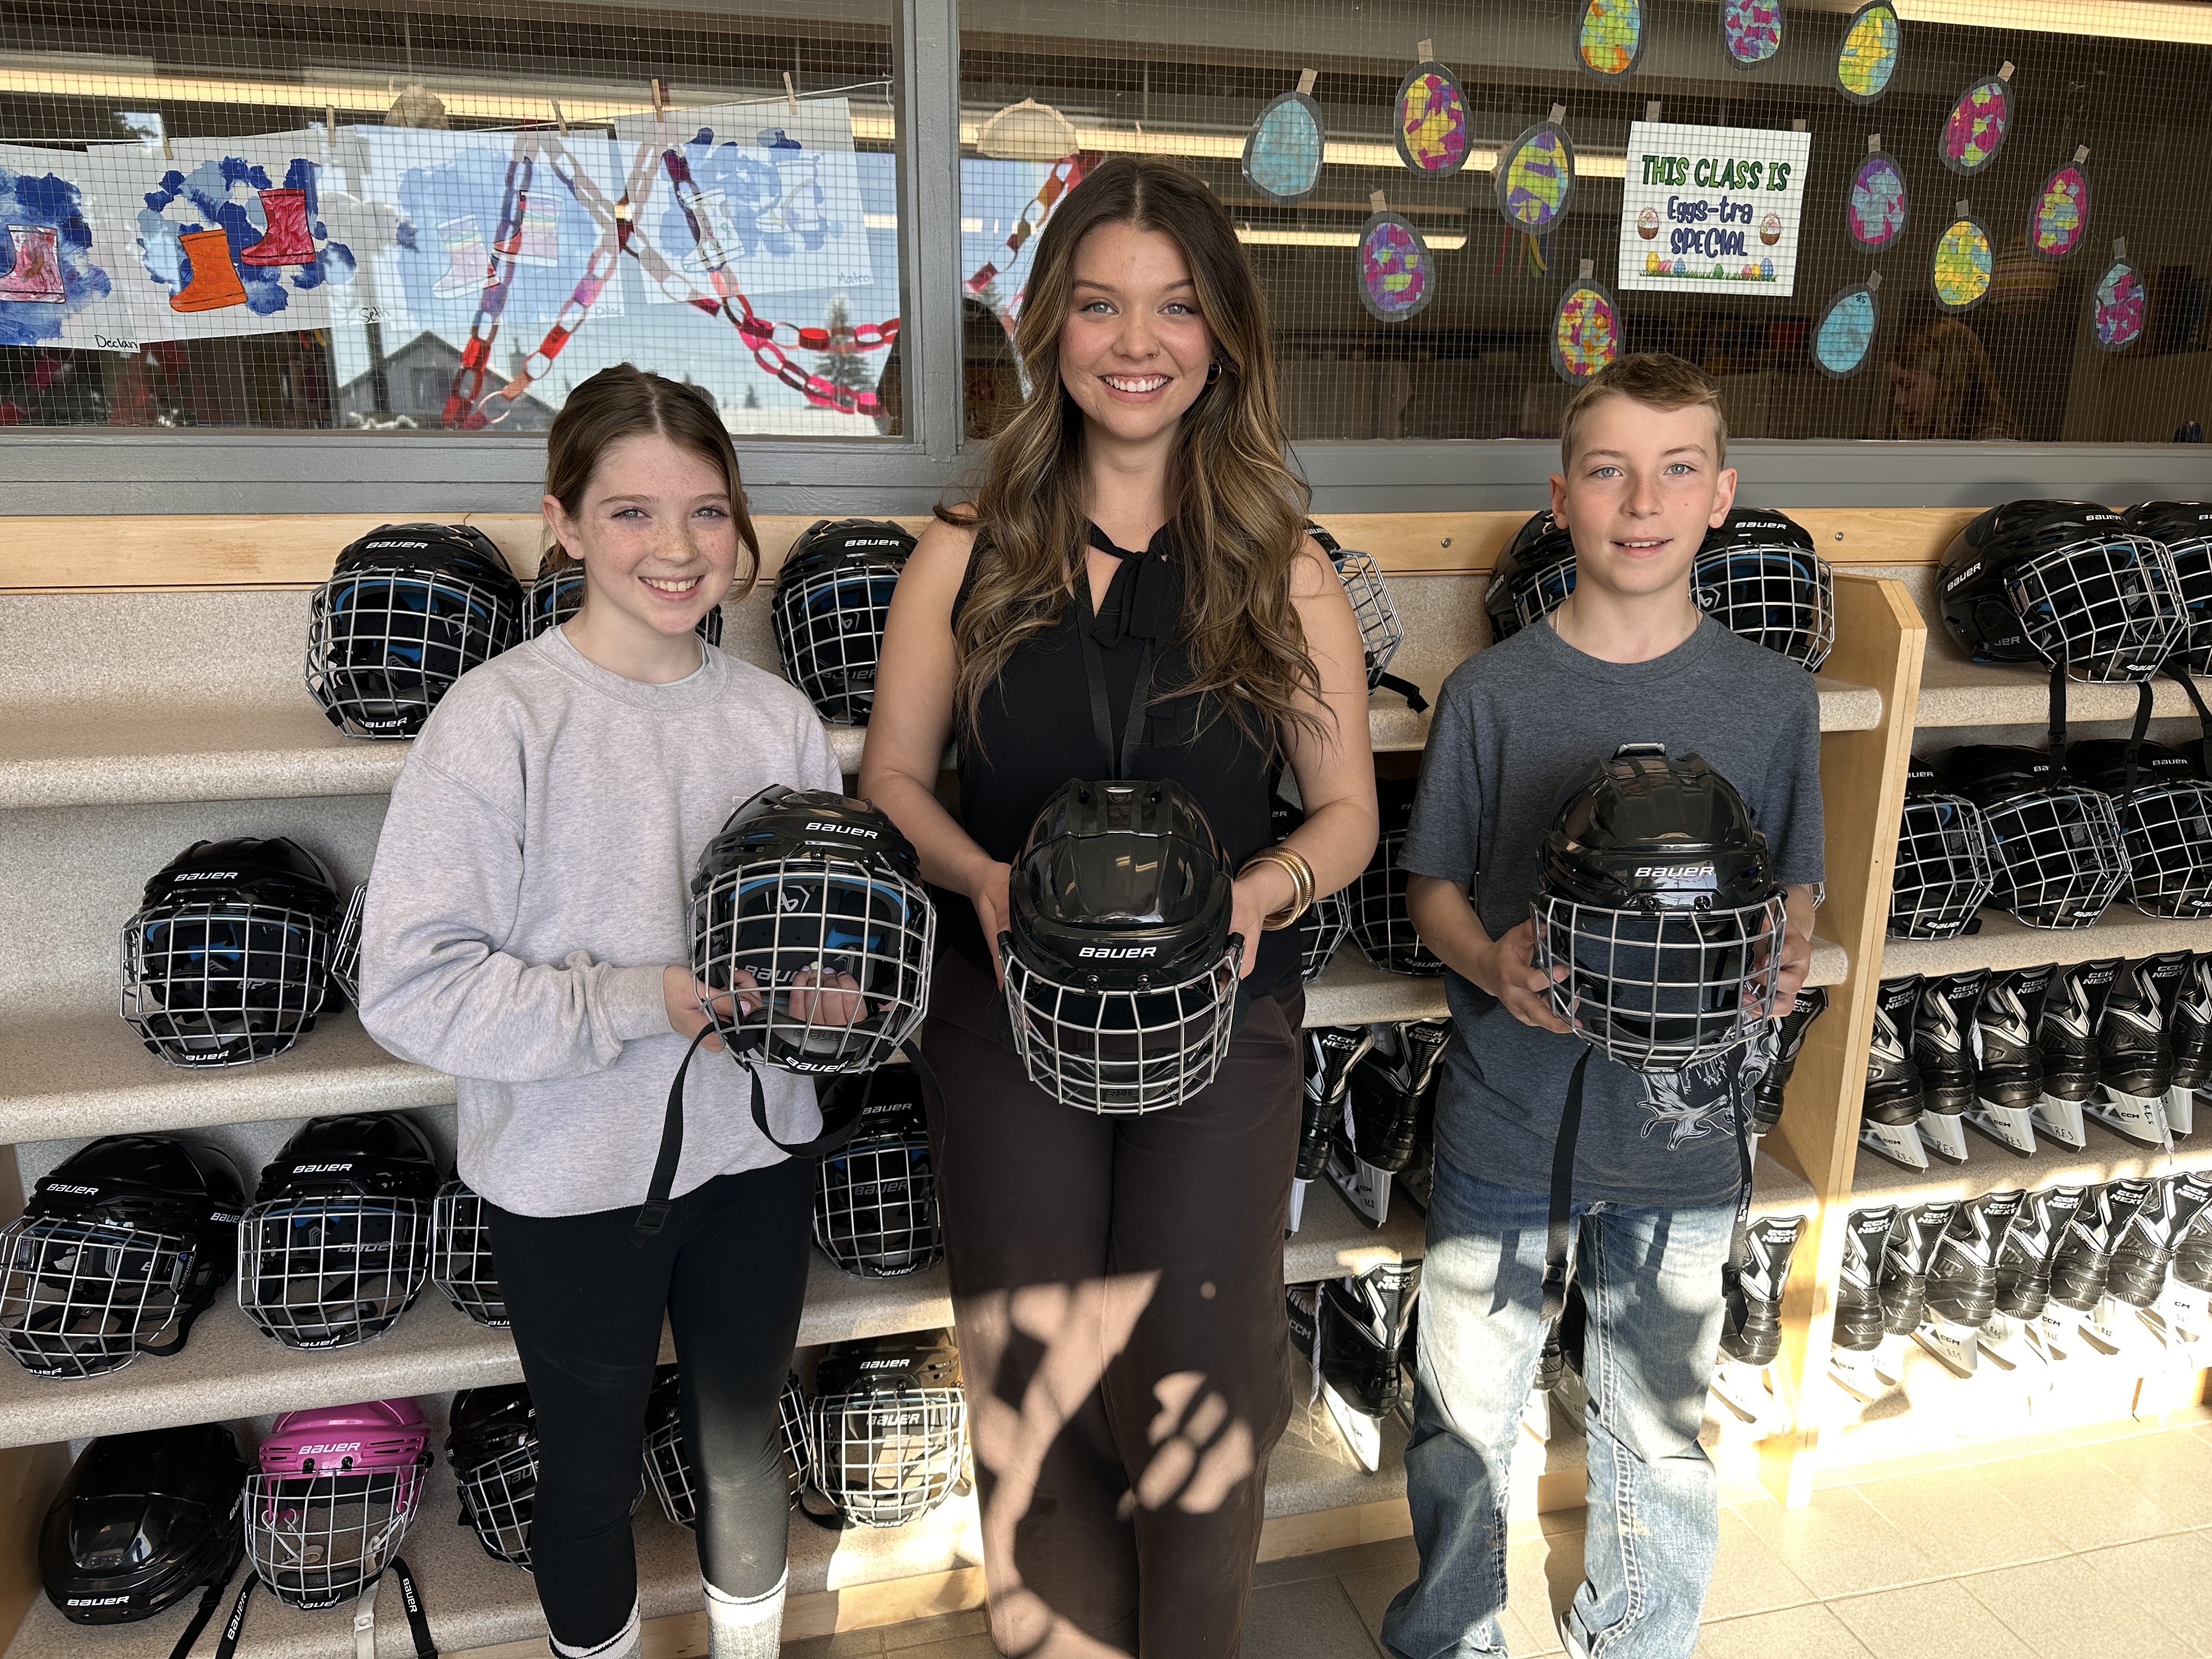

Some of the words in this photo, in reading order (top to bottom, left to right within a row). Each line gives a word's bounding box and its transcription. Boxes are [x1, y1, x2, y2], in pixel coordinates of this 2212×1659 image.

[1642, 155, 1689, 186] THIS
[1694, 158, 1763, 190] CLASS
[1767, 162, 1791, 191] IS
[1668, 196, 1753, 224] Eggs-tra
[1671, 228, 1748, 258] SPECIAL
[837, 272, 870, 285] Mateo
[359, 304, 390, 323] Seth
[95, 335, 138, 349] Declan
[365, 540, 428, 550] BAUER
[844, 539, 900, 548] BAUER
[1947, 562, 1982, 592] BAUER
[805, 822, 878, 840] BAUER
[174, 872, 238, 882] BAUER
[1634, 866, 1715, 878] BAUER
[1079, 946, 1157, 958] BAUER
[2152, 968, 2186, 978] NEXT
[2158, 963, 2183, 972] CCM
[2083, 974, 2115, 985] NEXT
[2088, 970, 2114, 978] CCM
[1953, 983, 1979, 993] CCM
[2017, 981, 2049, 995] NEXT
[2022, 977, 2049, 988] CCM
[1888, 989, 1914, 1003] CCM
[1948, 987, 1980, 1000] NEXT
[1884, 993, 1916, 1010] NEXT
[1414, 1026, 1444, 1036] CCM
[1328, 1034, 1357, 1043] CCM
[1409, 1032, 1446, 1043] NEXT
[1322, 1039, 1358, 1051] NEXT
[862, 1103, 912, 1114] BAUER
[292, 1164, 352, 1173] BAUER
[46, 1183, 99, 1195] BAUER
[2115, 1190, 2143, 1199] CCM
[2109, 1195, 2142, 1205] NEXT
[2175, 1189, 2208, 1203] NEXT
[1862, 1218, 1889, 1227] CCM
[1858, 1224, 1890, 1234] NEXT
[1761, 1234, 1798, 1243] NEXT
[1377, 1279, 1418, 1290] NEXT
[2042, 1316, 2061, 1327] CCM
[1940, 1335, 1960, 1345] CCM
[860, 1359, 910, 1370] BAUER
[298, 1442, 361, 1455] BAUER
[403, 1577, 418, 1613] BAUER
[67, 1595, 130, 1607] BAUER
[227, 1591, 247, 1640] BAUER
